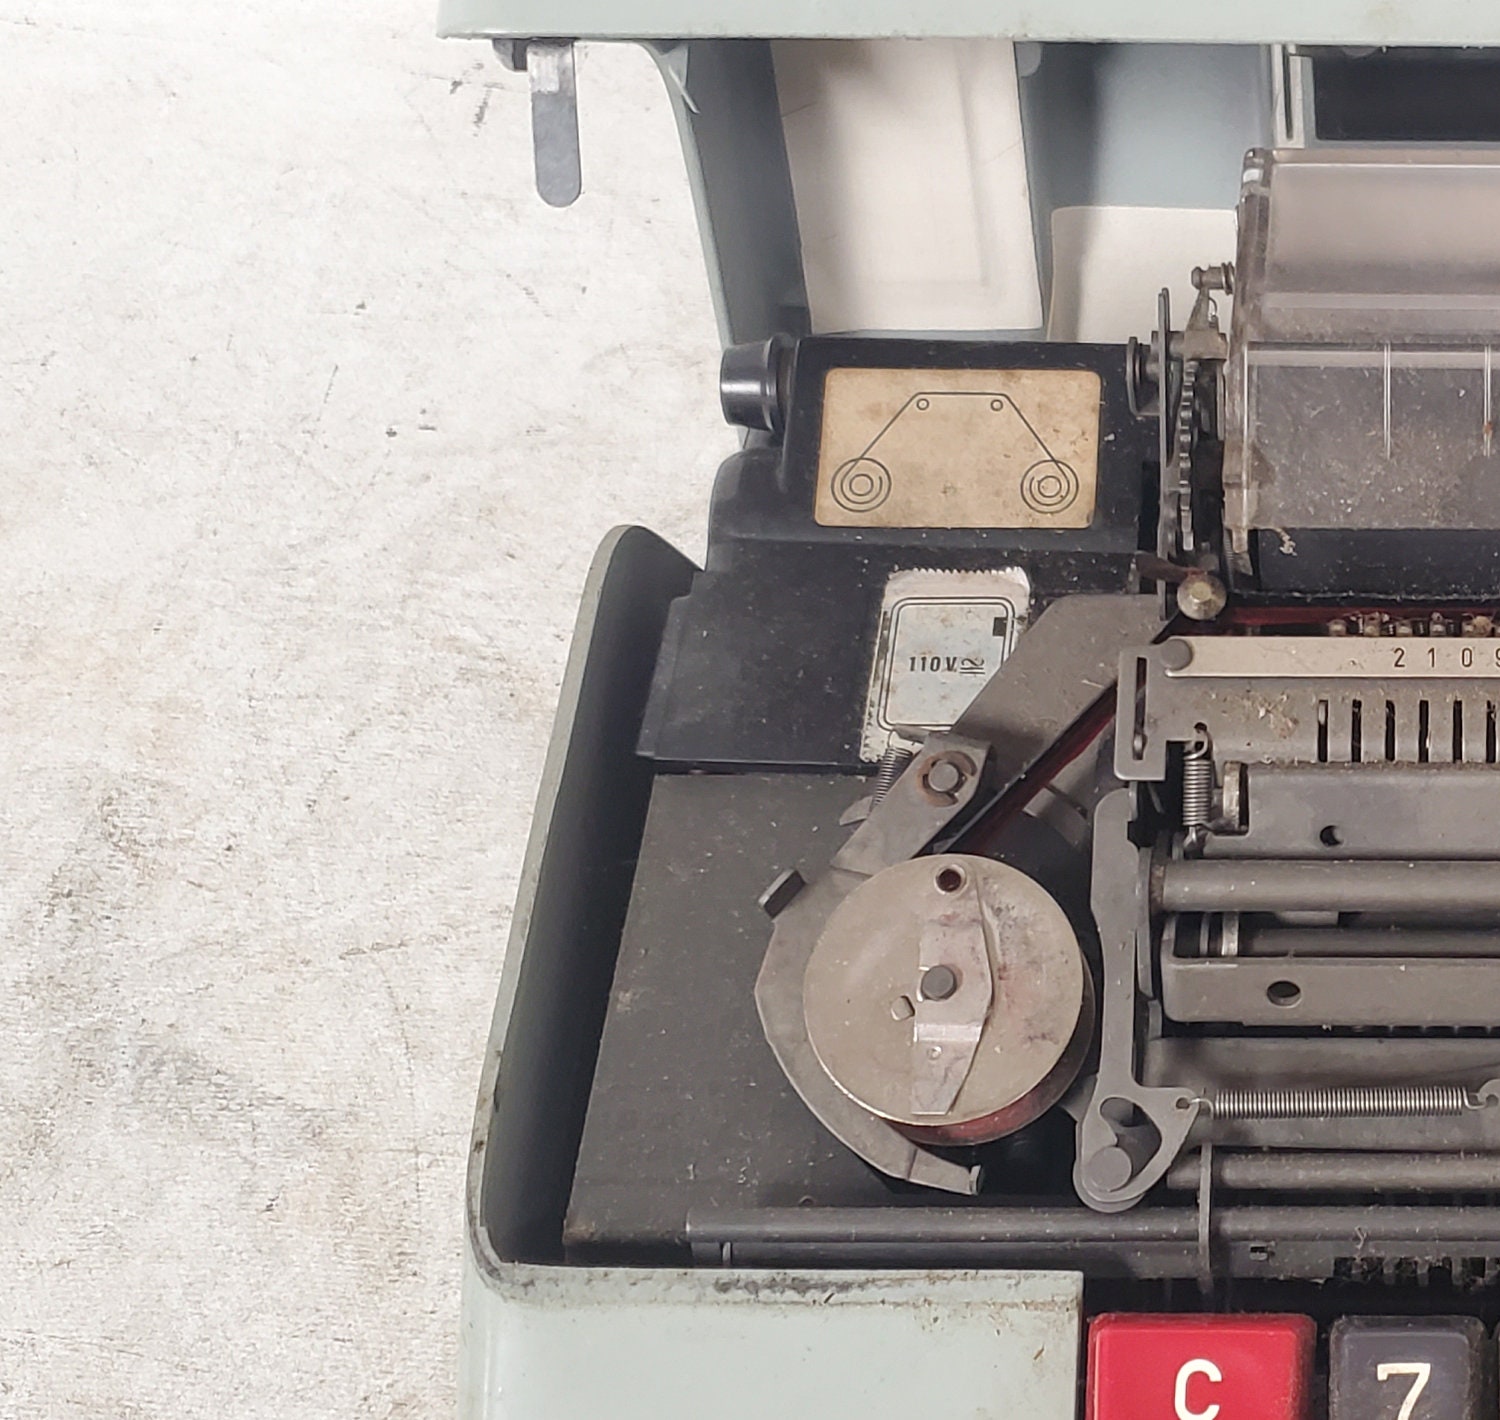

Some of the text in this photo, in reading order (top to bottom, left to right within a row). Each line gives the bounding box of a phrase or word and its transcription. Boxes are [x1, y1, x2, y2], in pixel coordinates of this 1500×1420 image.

[1393, 648, 1405, 667] 2
[1461, 648, 1473, 667] 0
[1174, 1358, 1222, 1420] C
[1377, 1362, 1432, 1420] 7
